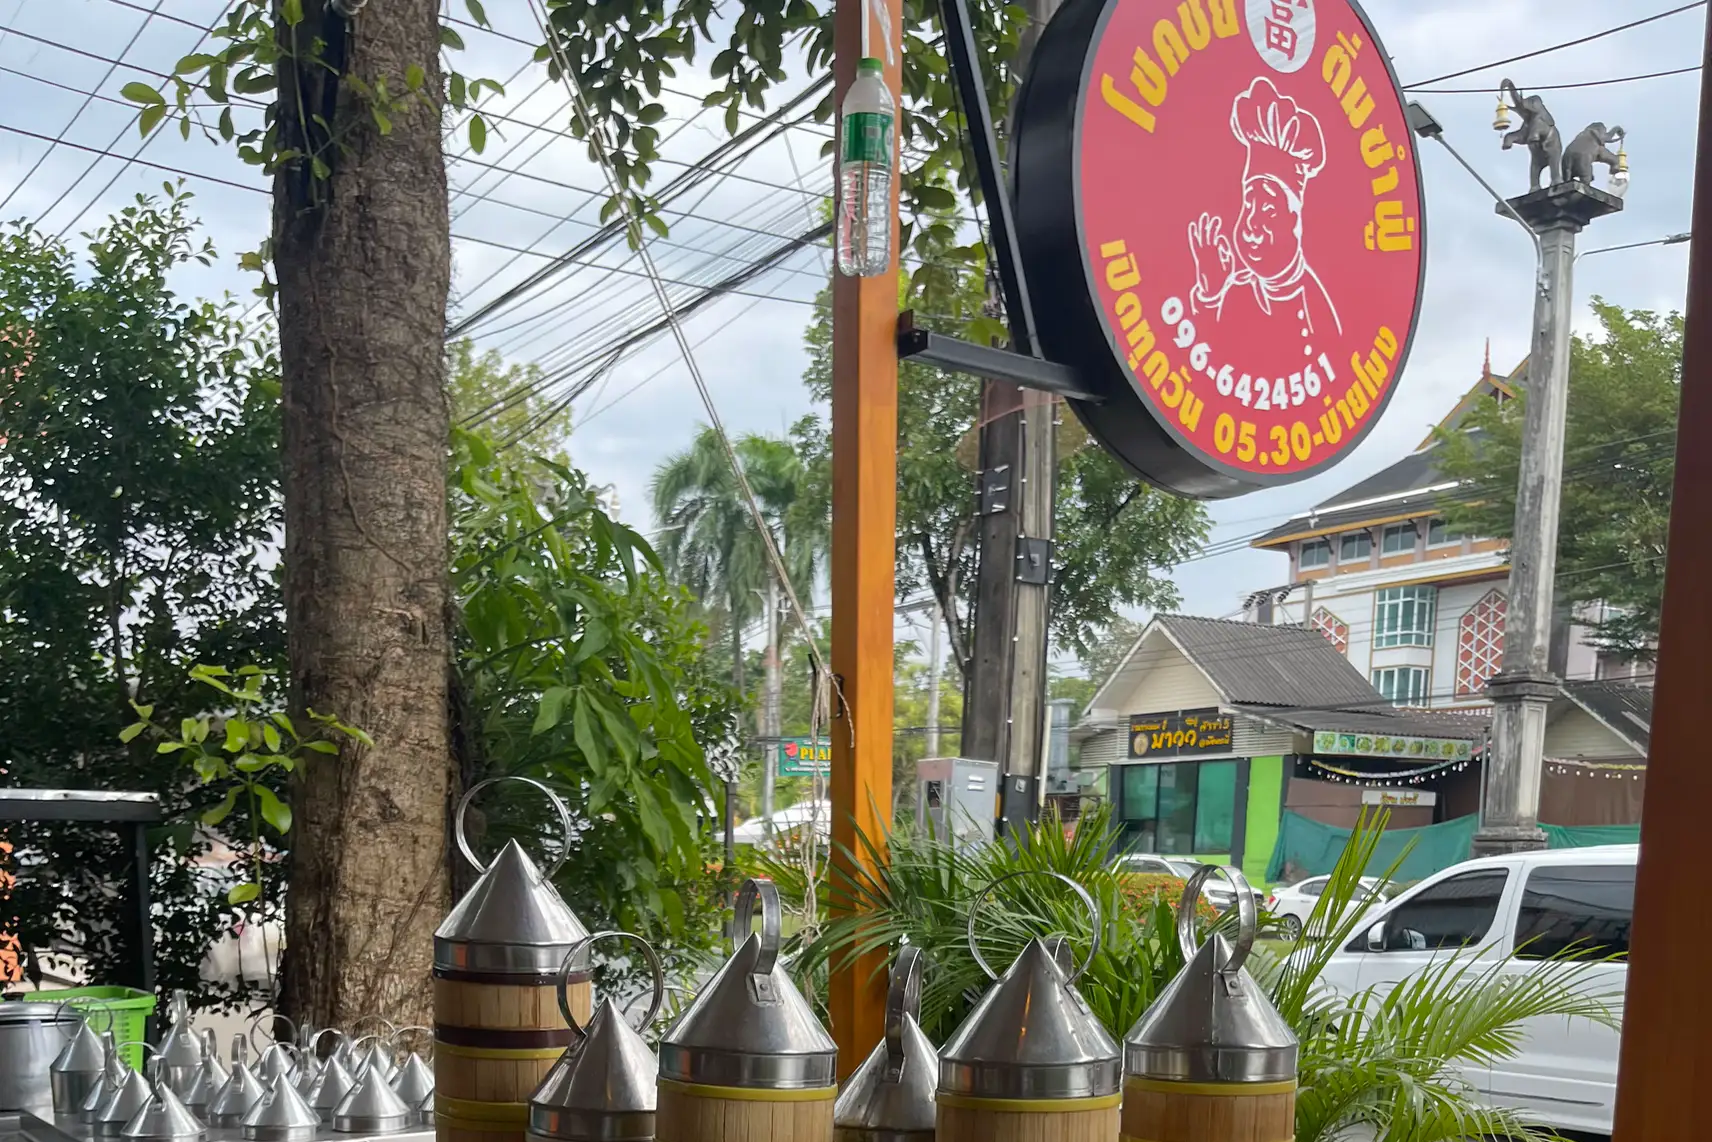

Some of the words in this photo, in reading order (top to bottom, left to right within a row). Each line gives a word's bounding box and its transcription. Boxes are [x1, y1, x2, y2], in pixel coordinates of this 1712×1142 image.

[1100, 239, 1205, 432] เปิดทุกวัน
[1213, 325, 1398, 465] 05.30-บ่ายโมง
[1161, 297, 1336, 410] 096-6424561
